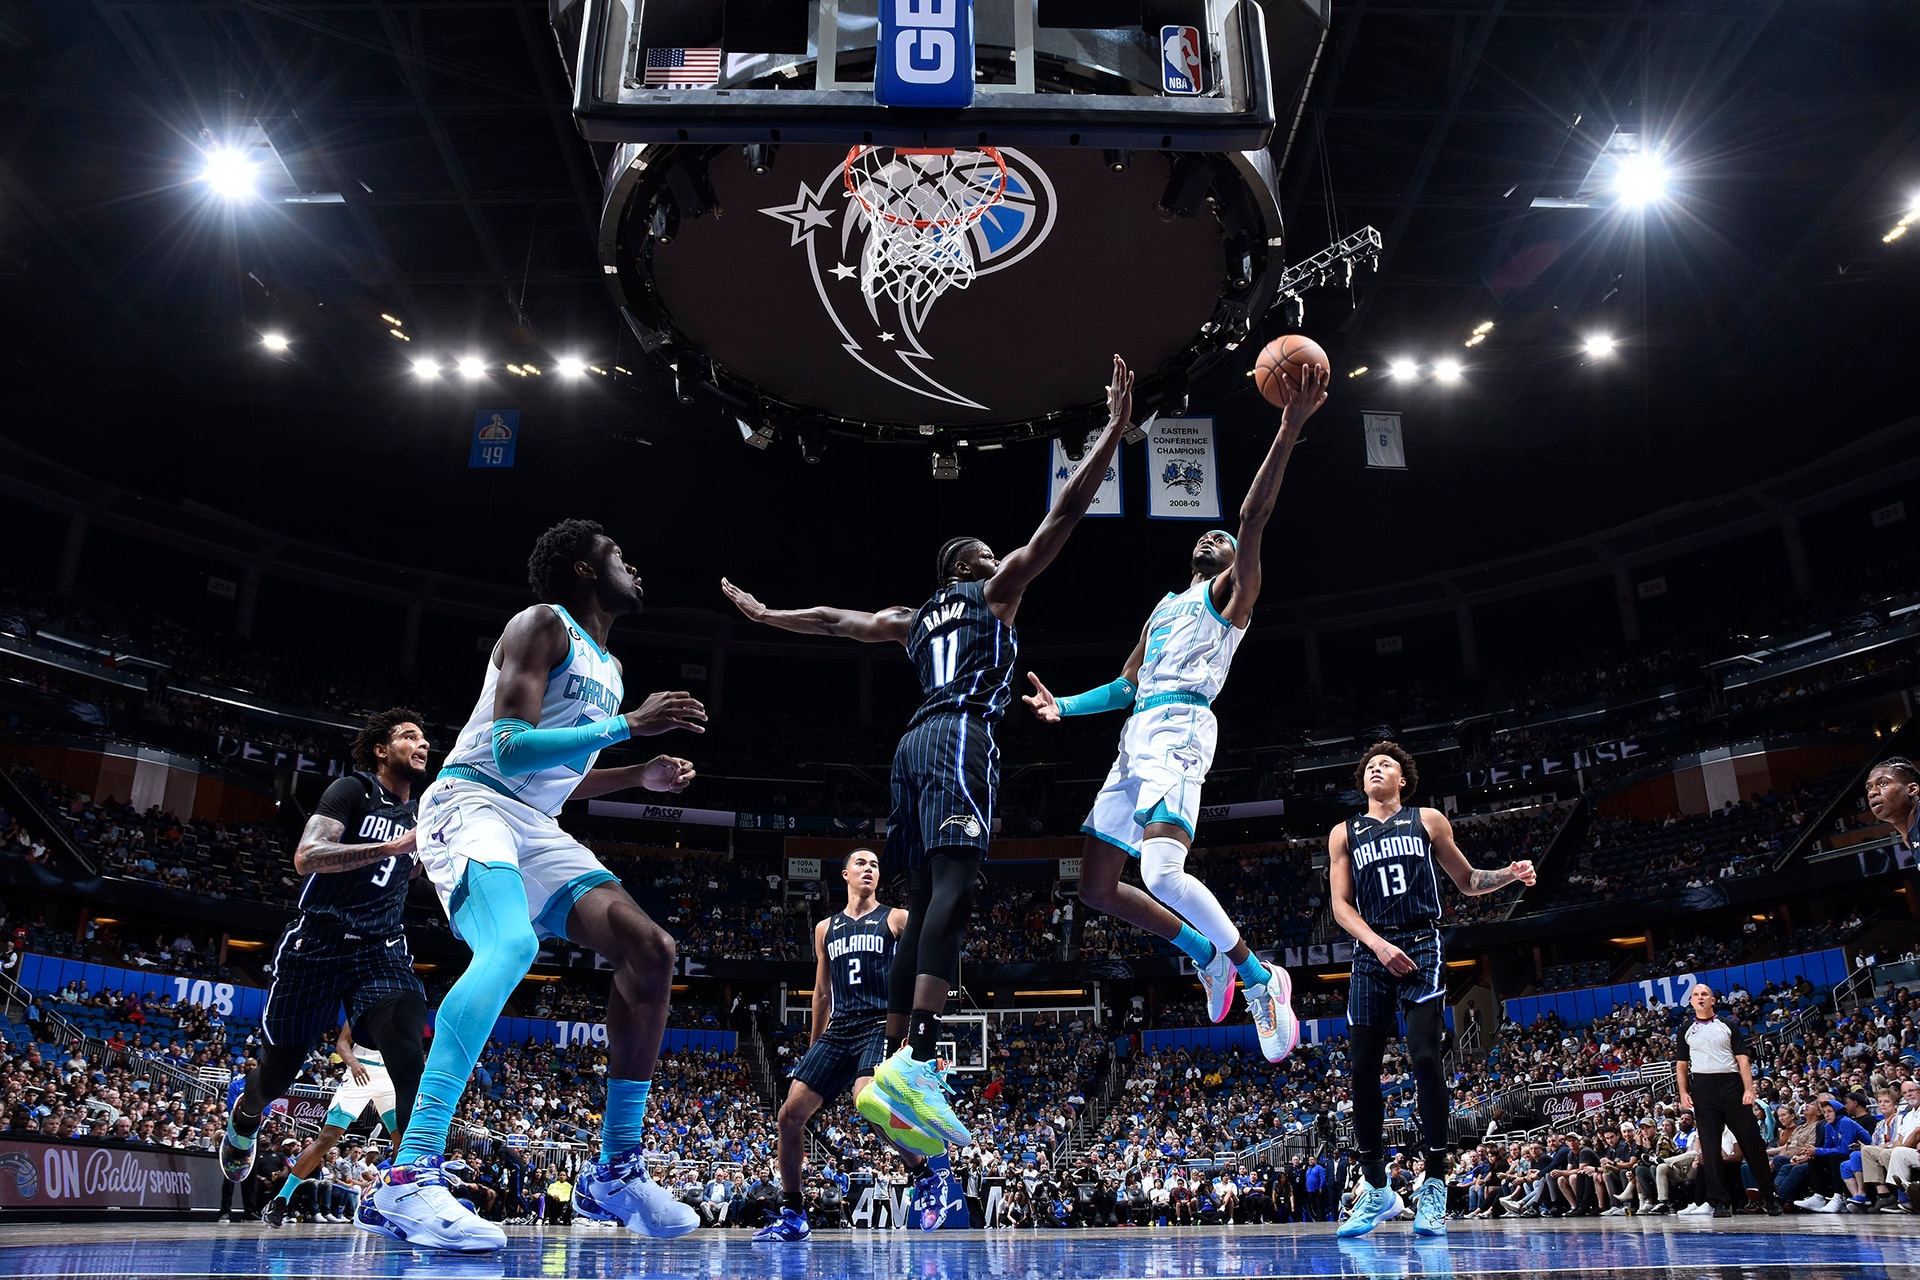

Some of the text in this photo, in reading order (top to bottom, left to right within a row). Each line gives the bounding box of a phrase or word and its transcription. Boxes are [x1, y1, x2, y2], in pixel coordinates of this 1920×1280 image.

[1168, 77, 1188, 89] NBA
[1153, 437, 1209, 445] CONFERENCE
[1161, 427, 1199, 435] EASTERN
[1380, 434, 1387, 447] 6
[482, 446, 504, 464] 49
[1156, 447, 1206, 455] CHAMPIONS
[930, 629, 958, 687] 11
[642, 805, 683, 819] MASSEY
[756, 815, 761, 827] 1
[788, 816, 796, 829] 3
[1353, 835, 1425, 870] ORLANDO
[371, 855, 397, 888] 3
[1377, 863, 1408, 898] 13
[827, 933, 884, 961] ORLANDO
[848, 958, 862, 985] 2
[174, 977, 235, 1017] 108
[1638, 972, 1698, 1010] 112
[555, 1021, 610, 1050] 109
[294, 1101, 329, 1123] Bally
[1543, 1096, 1578, 1116] Bally
[44, 1148, 192, 1206] ON Bally SPORTS
